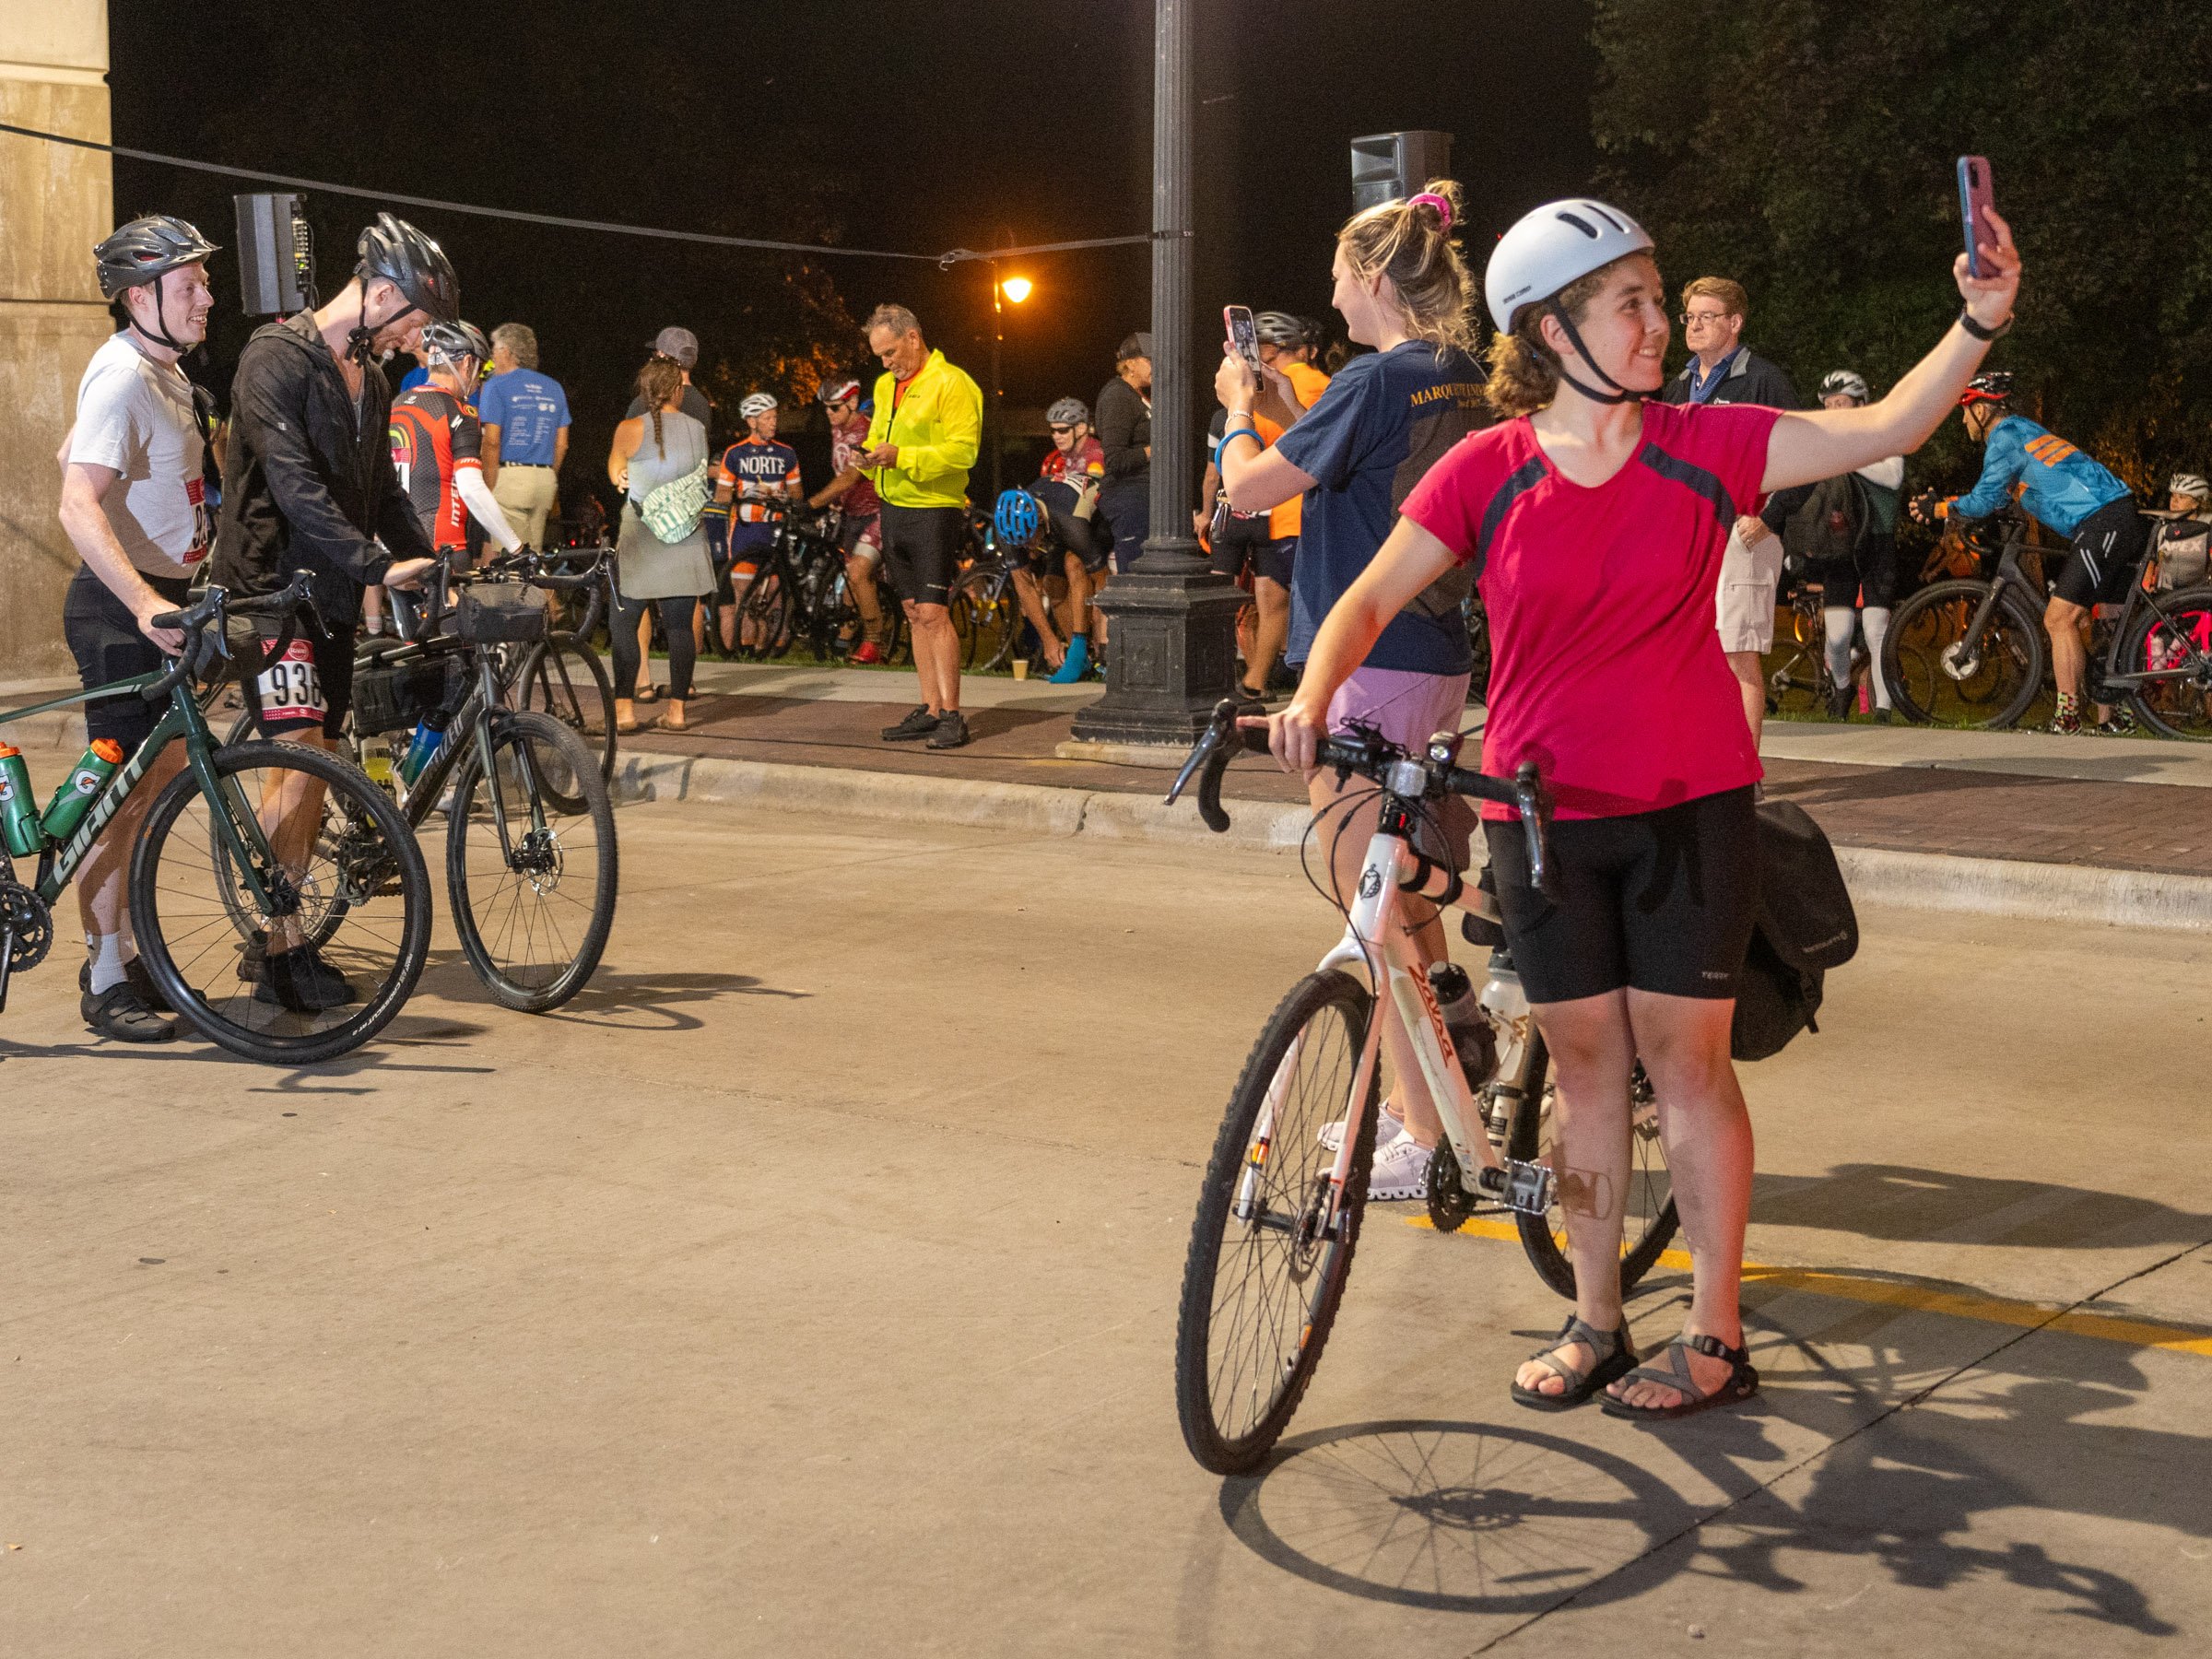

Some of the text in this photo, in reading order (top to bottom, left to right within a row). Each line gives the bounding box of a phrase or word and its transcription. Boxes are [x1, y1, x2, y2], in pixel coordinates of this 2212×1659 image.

[739, 457, 785, 475] NORTE
[76, 771, 101, 794] G
[53, 740, 148, 885] GIANT
[368, 982, 401, 1026] CROSSCUT
